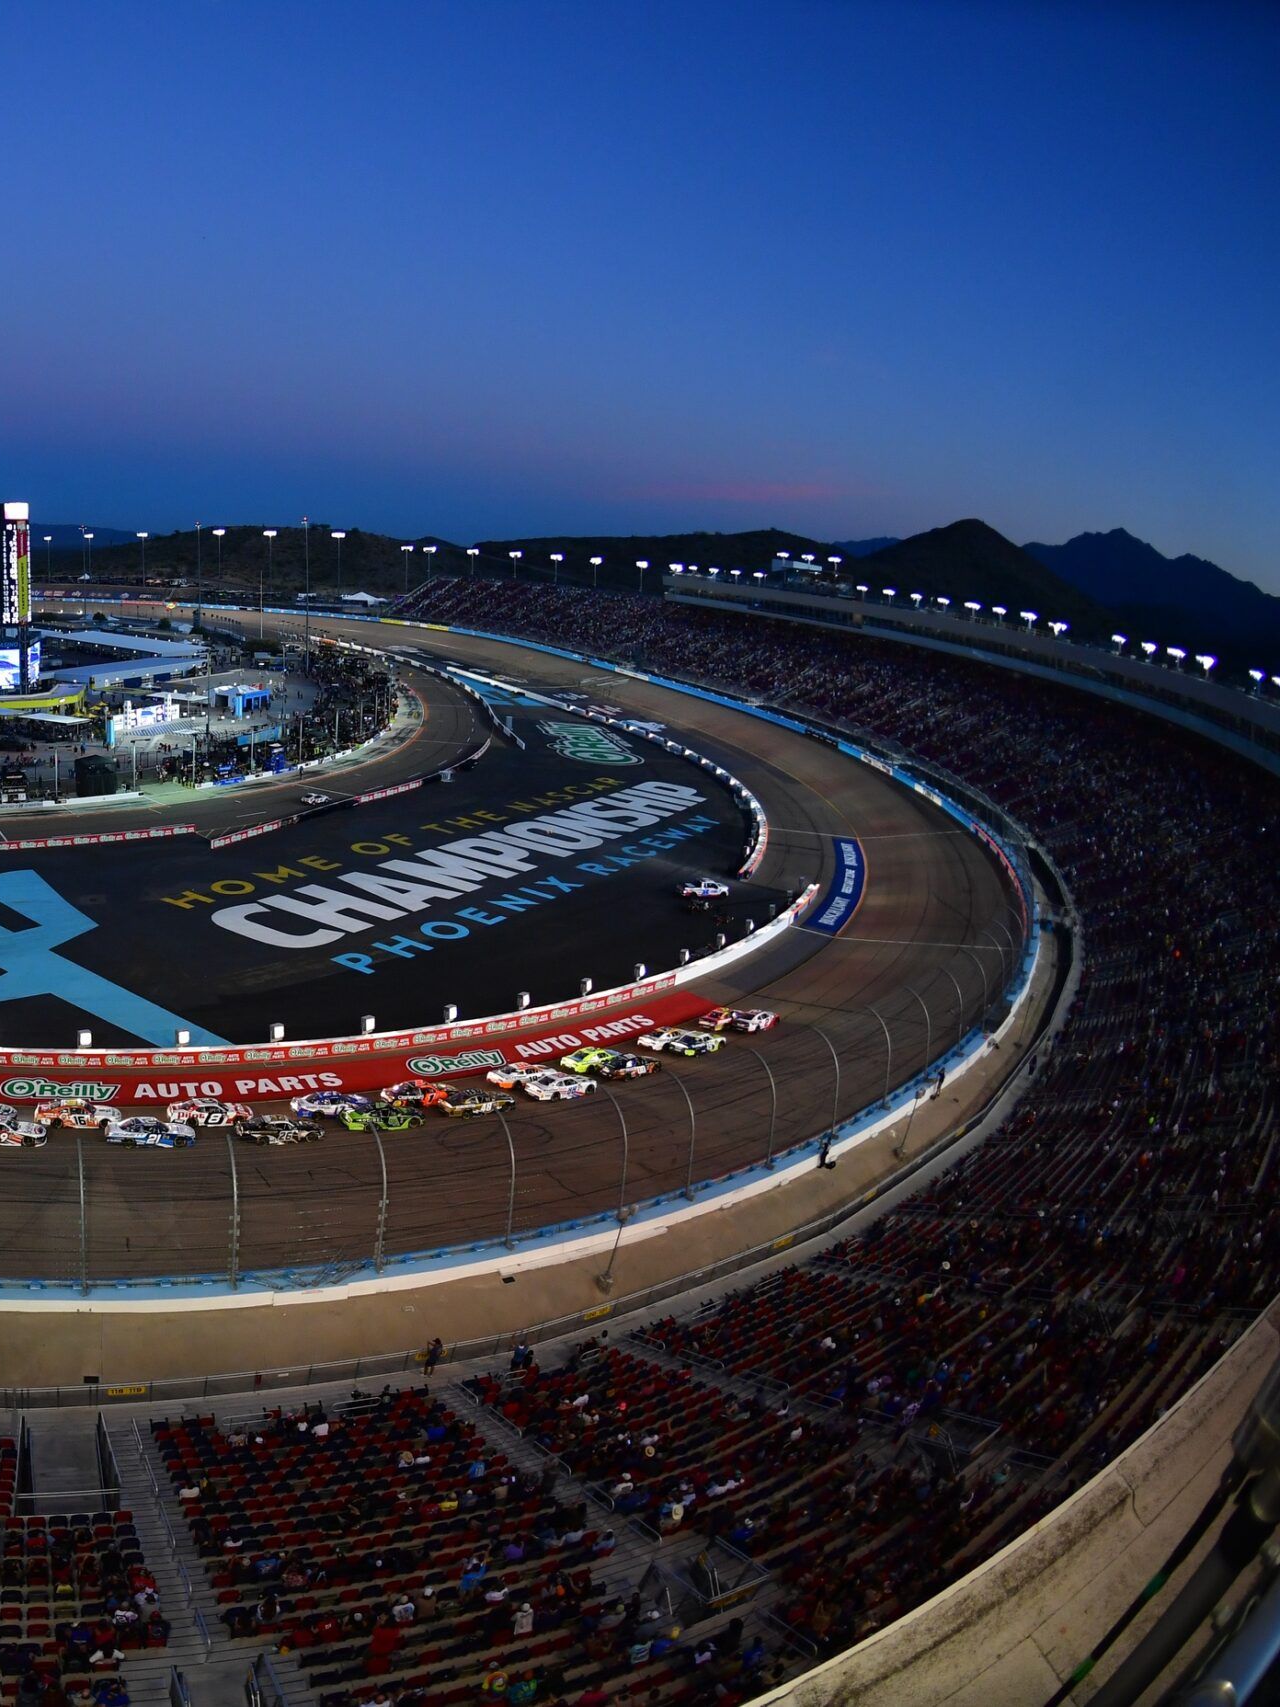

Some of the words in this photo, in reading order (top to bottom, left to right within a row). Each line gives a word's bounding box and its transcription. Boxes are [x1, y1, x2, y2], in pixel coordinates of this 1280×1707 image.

[160, 855, 343, 910] HOME
[350, 833, 414, 855] OF
[420, 810, 509, 834] THE
[506, 776, 627, 813] NASCAR
[211, 781, 708, 948] CHAMPIONSHIP
[330, 874, 585, 974] PHOENIX
[576, 814, 721, 876] RACEWAY
[332, 1042, 358, 1054] O'Reilly
[412, 1050, 499, 1076] O'Reilly
[514, 1034, 582, 1058] AUTO
[580, 1014, 654, 1042] PARTS
[244, 1050, 271, 1060] O'Reilly
[289, 1046, 316, 1058] O'Reilly
[11, 1054, 40, 1065] O'Reilly
[58, 1055, 87, 1066] O'Reilly
[105, 1055, 135, 1066] O'Reilly
[152, 1054, 182, 1065] O'Reilly
[199, 1052, 227, 1064] O'Reilly
[4, 1078, 113, 1098] O'Reilly
[134, 1081, 223, 1099] AUTO
[235, 1072, 343, 1095] PARTS
[481, 1102, 493, 1112] 48
[73, 1116, 86, 1126] 16
[208, 1114, 222, 1124] 8
[146, 1134, 160, 1145] 21
[278, 1131, 294, 1140] 26
